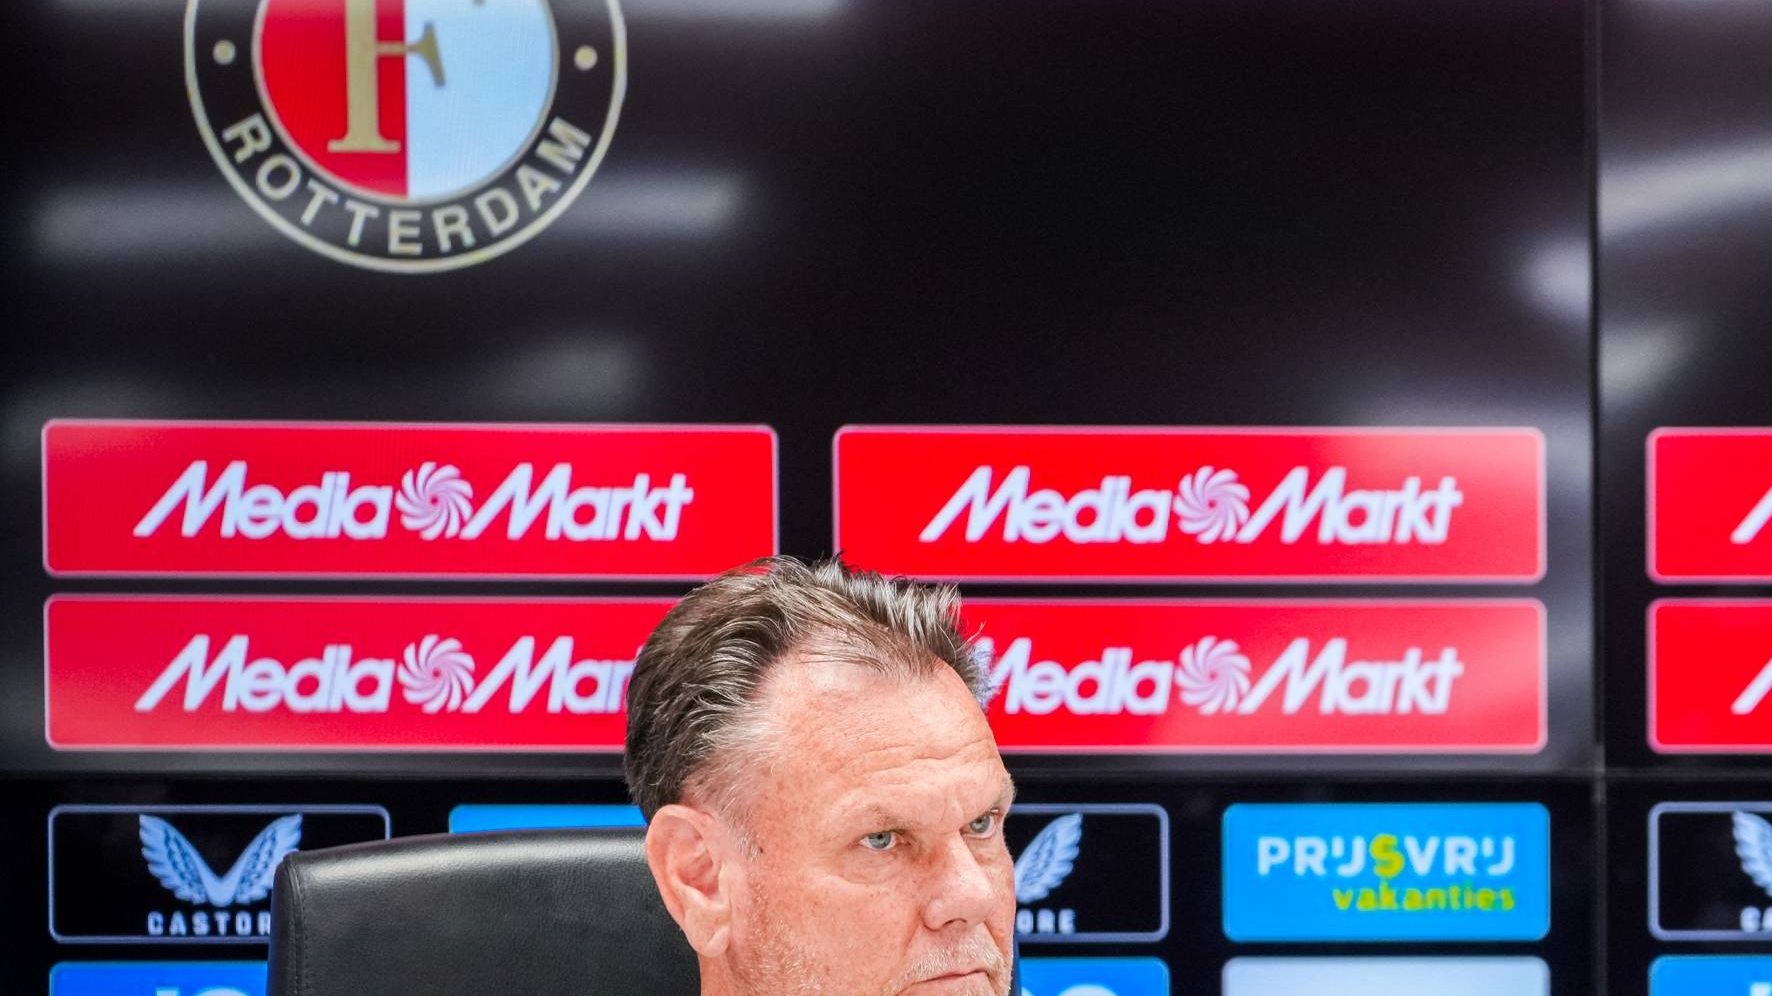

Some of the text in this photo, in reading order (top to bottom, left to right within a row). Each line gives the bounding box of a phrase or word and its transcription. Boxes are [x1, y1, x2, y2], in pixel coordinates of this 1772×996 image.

[223, 115, 590, 255] ROTTERDAM
[134, 461, 693, 541] Media Markt
[919, 466, 1461, 544] Media Markt
[135, 635, 629, 714] Media Mar
[1240, 637, 1463, 715] Markt
[1332, 883, 1515, 911] vakanties
